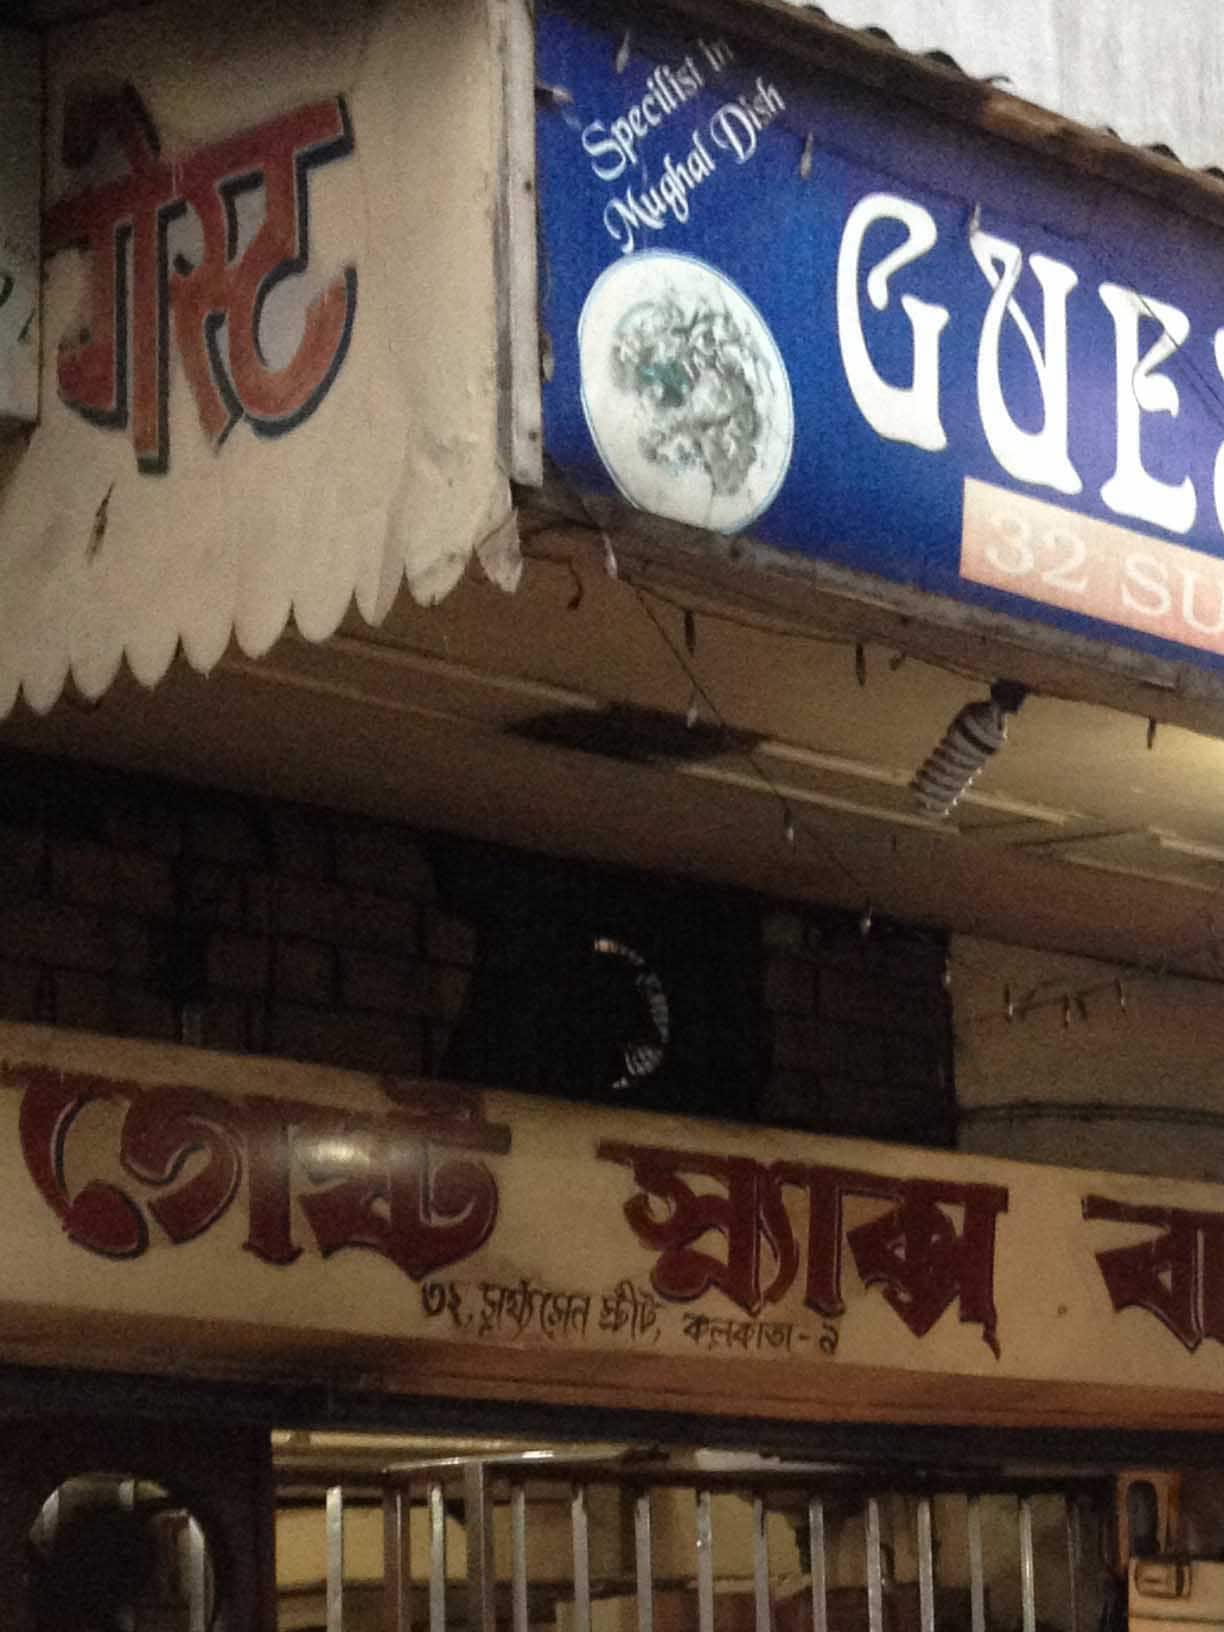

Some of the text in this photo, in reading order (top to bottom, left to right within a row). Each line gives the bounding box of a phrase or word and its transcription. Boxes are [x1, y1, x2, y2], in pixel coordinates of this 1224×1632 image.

[604, 76, 785, 254] Mughal Dish
[985, 515, 1088, 594] 32
